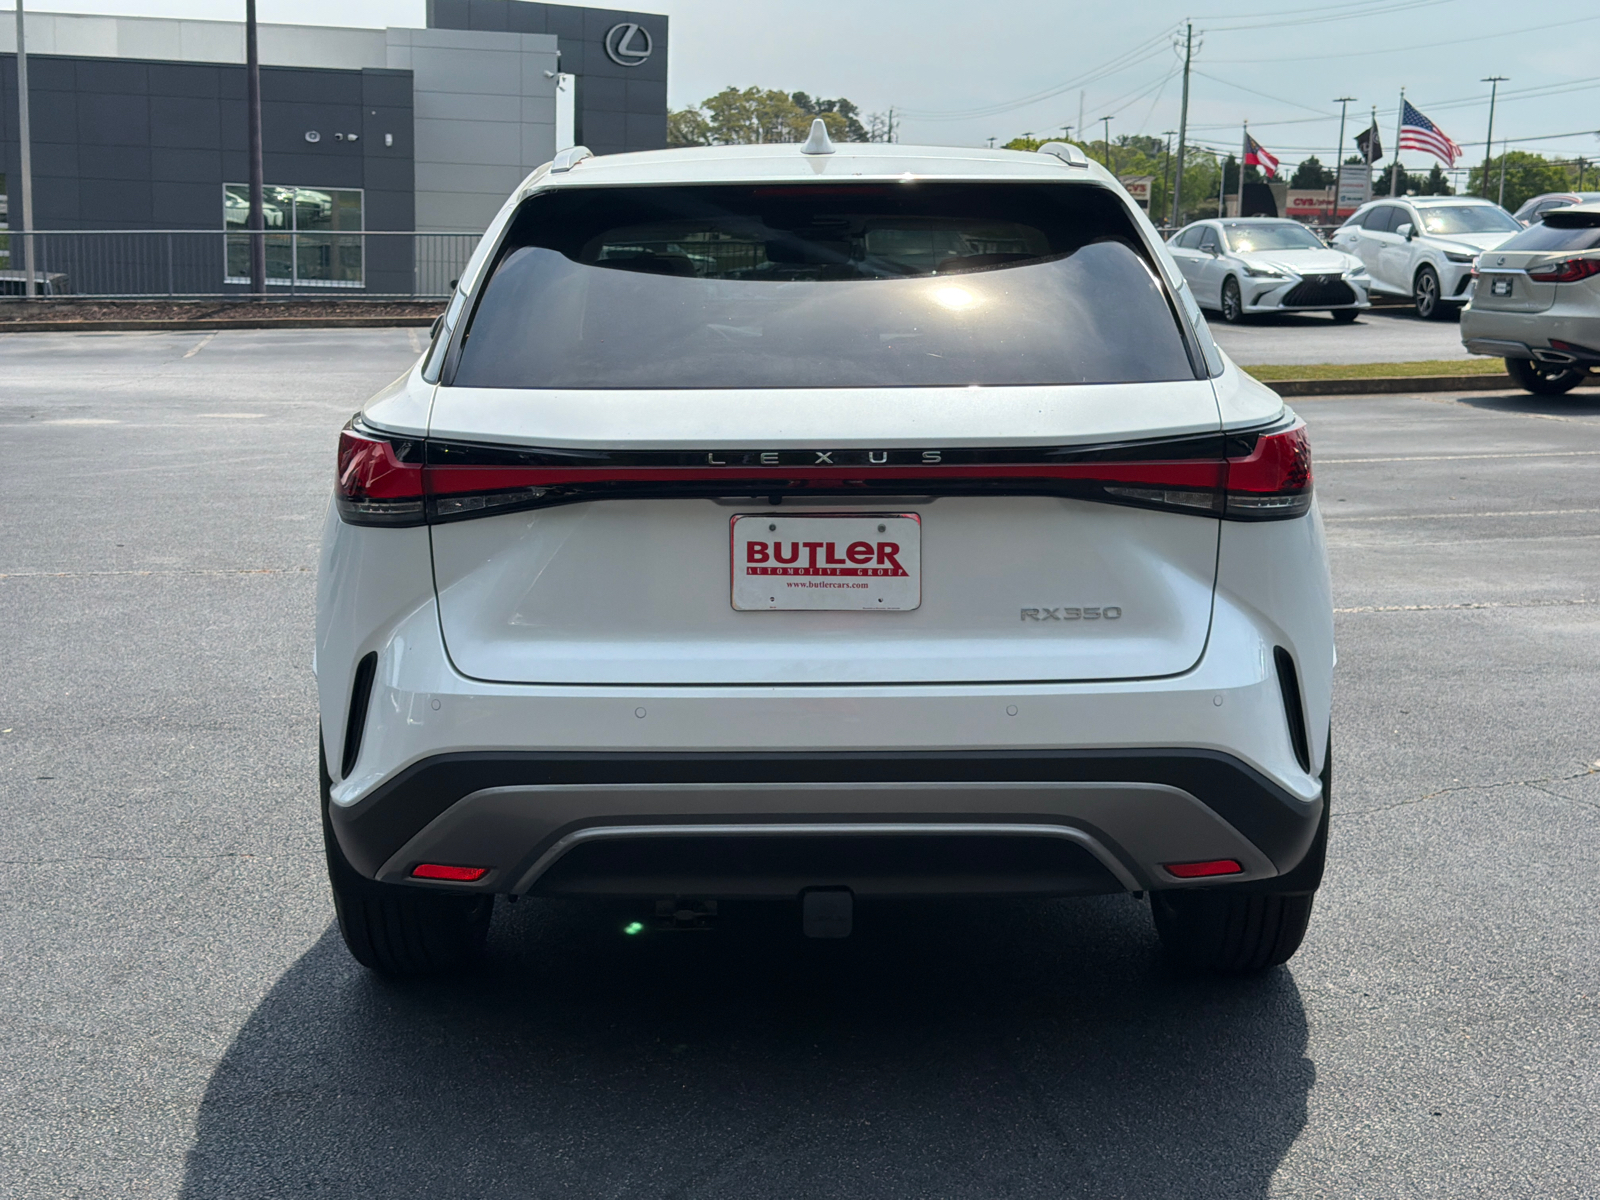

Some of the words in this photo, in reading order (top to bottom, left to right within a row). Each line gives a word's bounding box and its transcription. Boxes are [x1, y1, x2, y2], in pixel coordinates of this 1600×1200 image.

[708, 451, 942, 465] LEXUS
[747, 567, 842, 576] AUTOMOTIVE
[857, 568, 904, 576] GROUP
[786, 580, 869, 589] www.butlercars.com
[1020, 606, 1122, 621] RX350
